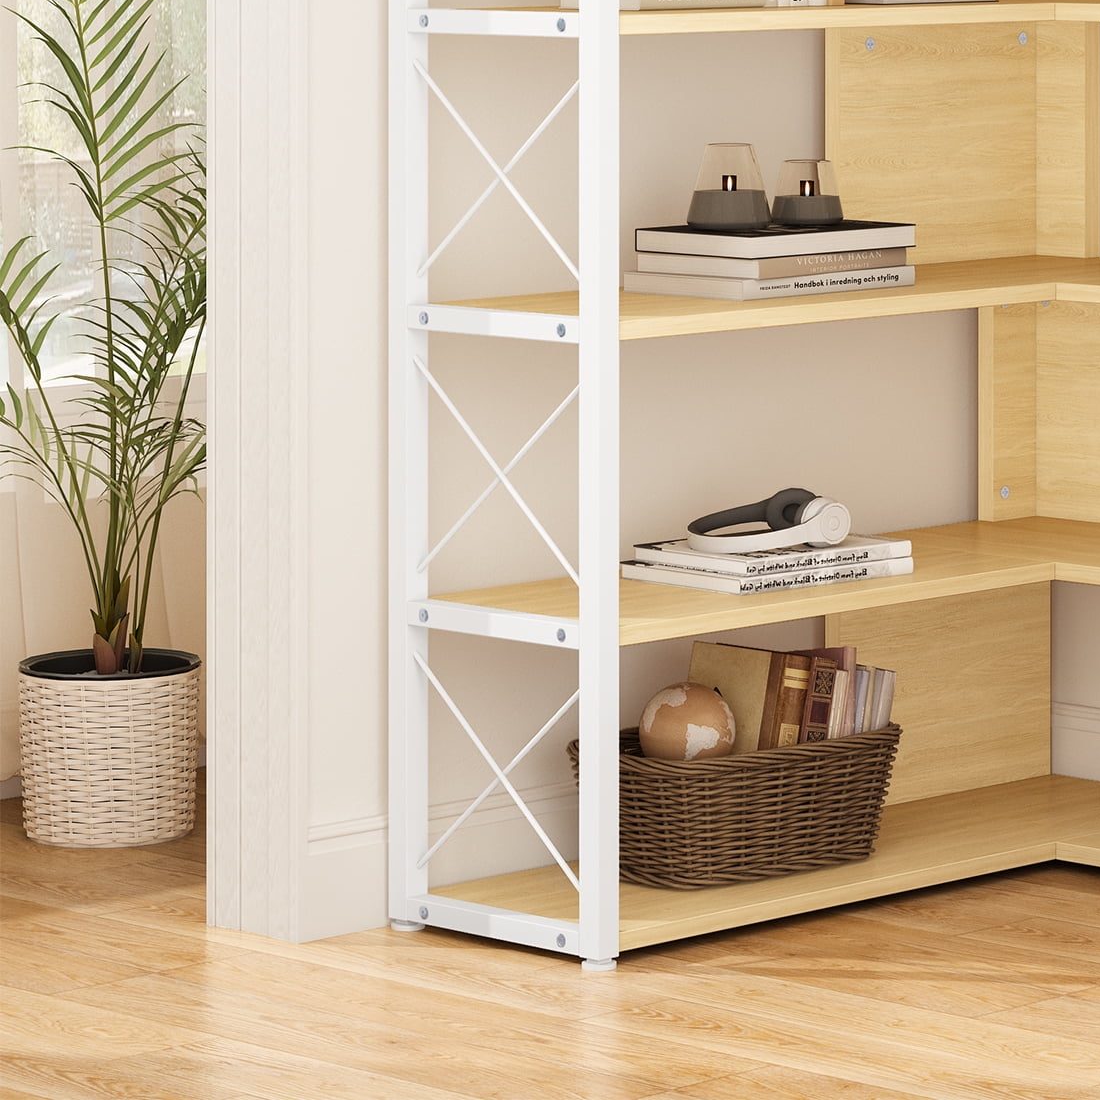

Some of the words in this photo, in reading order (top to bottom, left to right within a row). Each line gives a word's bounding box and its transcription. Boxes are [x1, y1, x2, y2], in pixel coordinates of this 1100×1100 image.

[796, 252, 844, 265] VICTORIA
[848, 251, 882, 260] HAGAN
[794, 281, 824, 289] Handbok
[830, 276, 862, 286] inredning
[864, 275, 875, 283] och
[877, 274, 899, 283] styling
